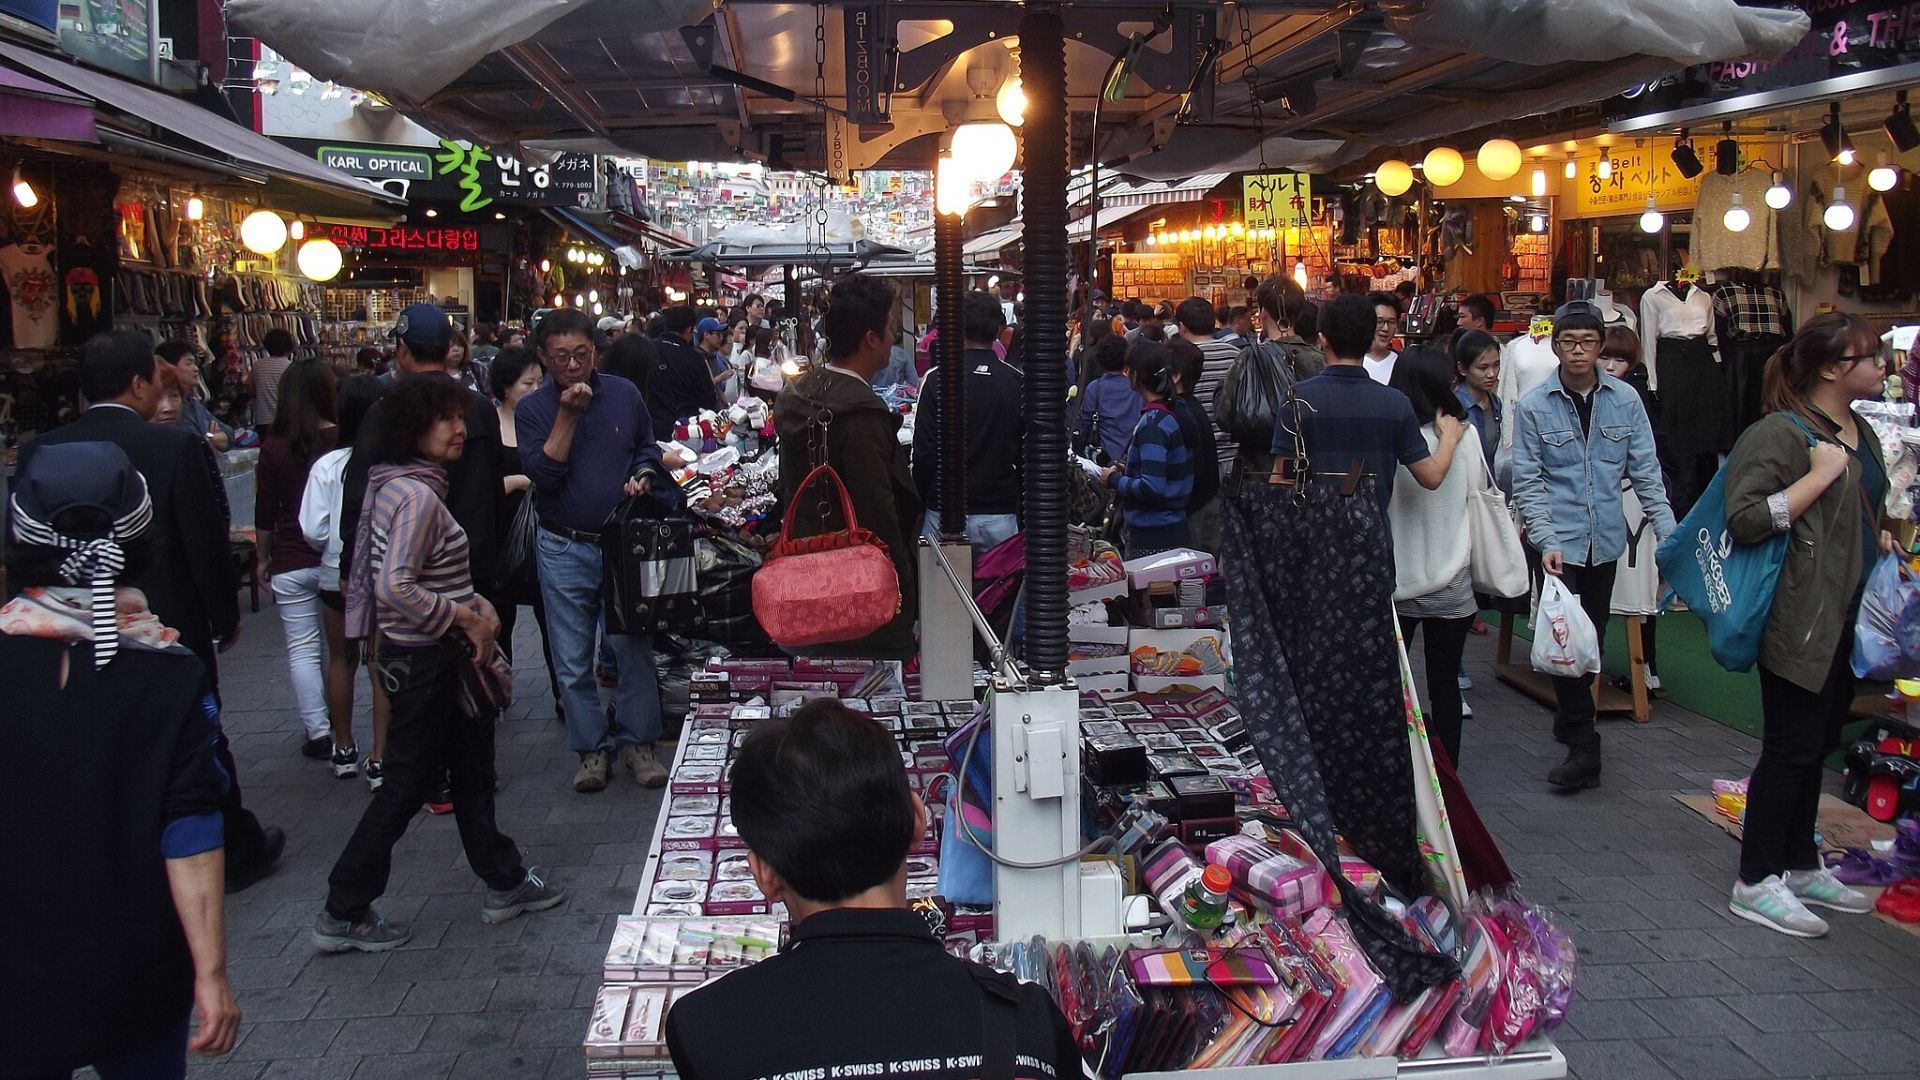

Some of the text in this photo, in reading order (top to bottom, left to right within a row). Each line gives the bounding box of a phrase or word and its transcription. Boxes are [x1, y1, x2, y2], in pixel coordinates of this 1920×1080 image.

[1829, 21, 1848, 56] &
[327, 156, 425, 173] KARL OPTICAL
[557, 158, 592, 171] メガネ
[1611, 155, 1641, 171] Belt
[1248, 176, 1306, 192] ベルト
[1631, 167, 1672, 187] ベルト
